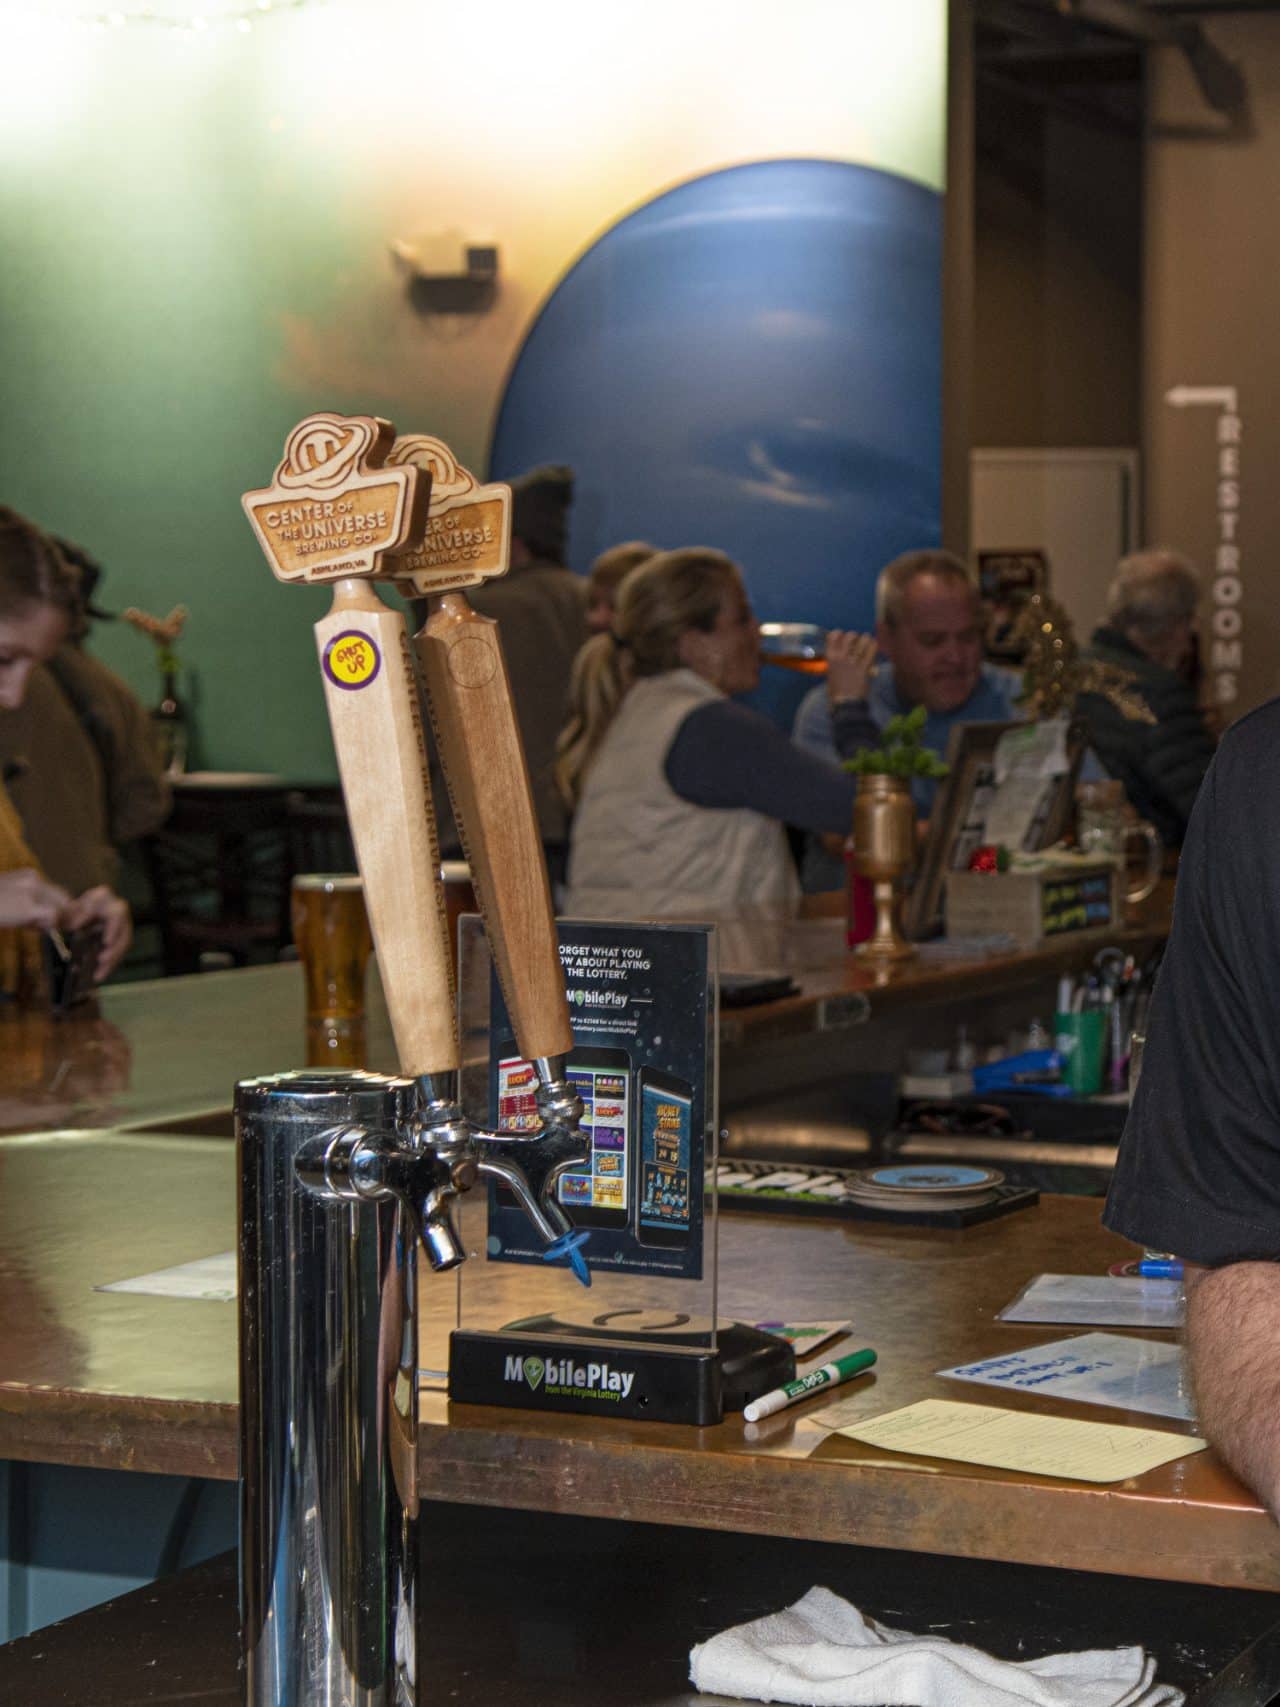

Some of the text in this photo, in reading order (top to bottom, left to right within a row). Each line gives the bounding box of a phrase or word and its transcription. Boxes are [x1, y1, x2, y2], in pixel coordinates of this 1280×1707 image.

[265, 502, 353, 528] CENTER OF
[278, 511, 387, 541] THE UNIVERSE
[296, 538, 349, 556] BREWING
[1213, 414, 1242, 700] RESTROOMS
[558, 945, 642, 959] ORGET WHAT YOU
[567, 967, 584, 977] THE
[576, 958, 607, 968] ABOUT
[609, 959, 650, 970] PLAYING
[598, 1390, 620, 1402] Lottery
